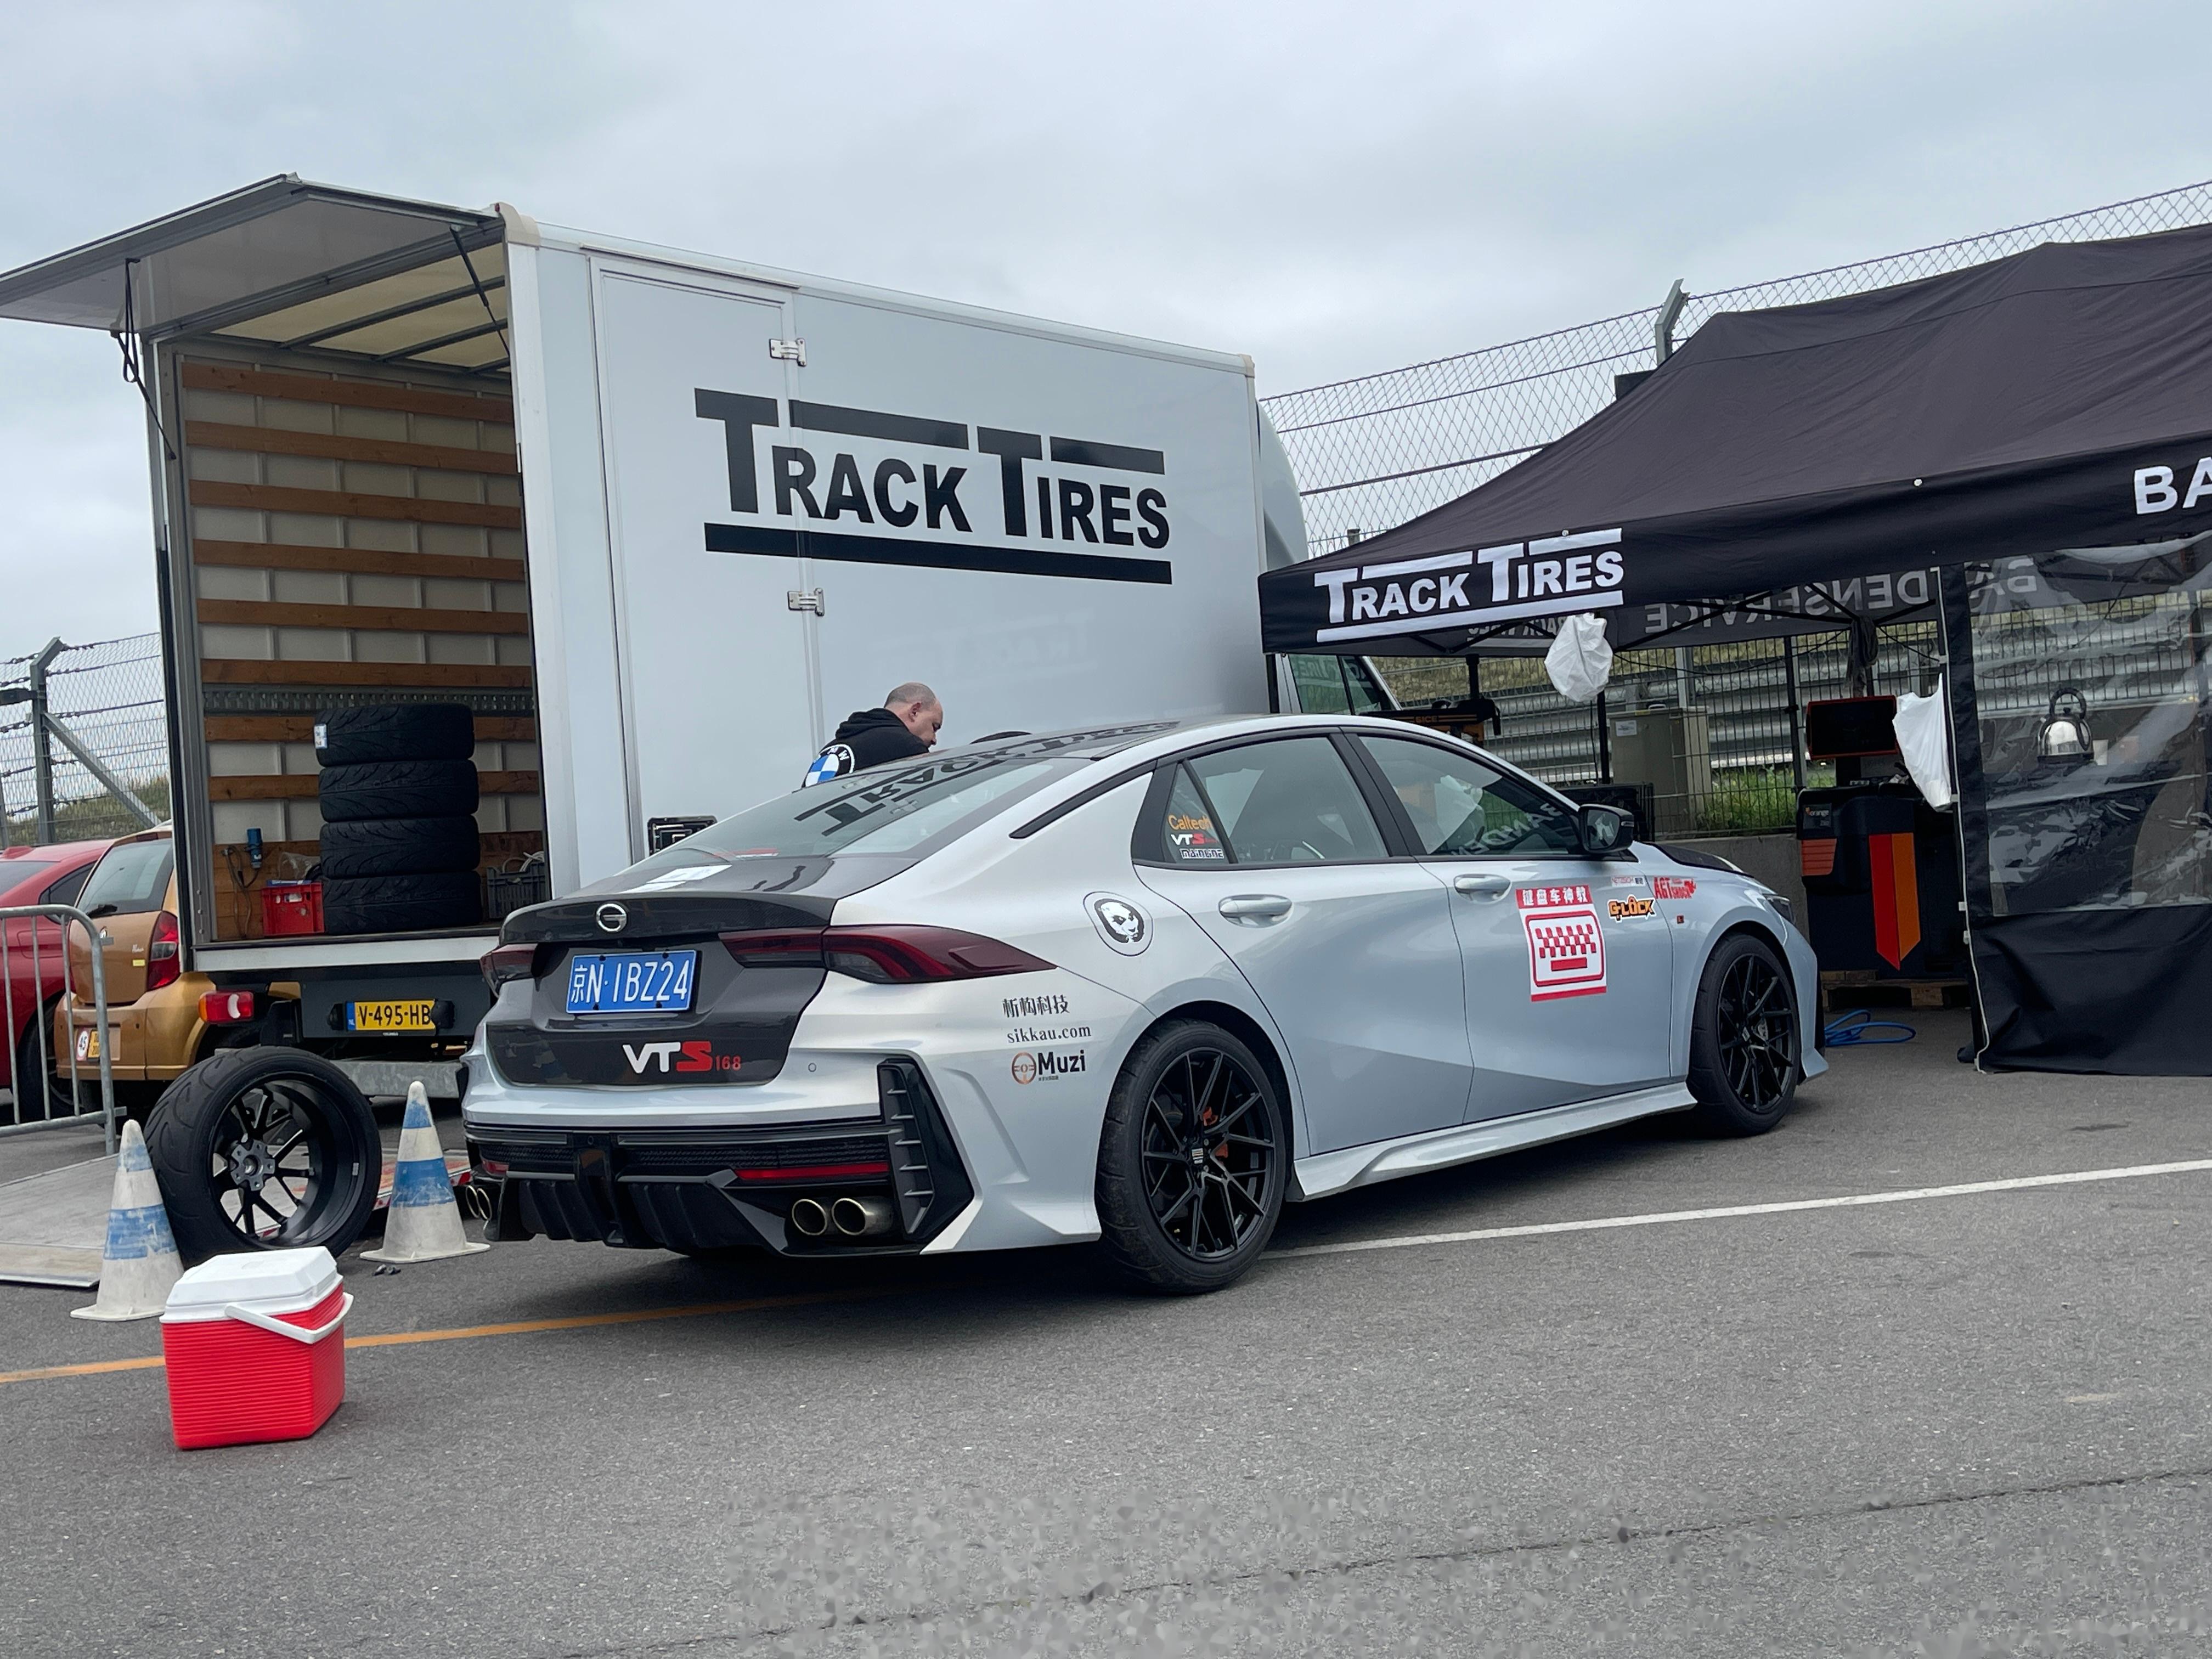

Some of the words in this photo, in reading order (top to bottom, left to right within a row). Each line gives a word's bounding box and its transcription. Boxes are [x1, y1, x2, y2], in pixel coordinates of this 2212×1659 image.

[695, 387, 973, 533] TRACK
[977, 426, 1170, 549] TIRES
[1314, 567, 1470, 624] TRACK
[1477, 542, 1624, 602] TIRES
[1007, 1026, 1091, 1043] sikkau.com
[622, 1040, 713, 1074] VTS
[1037, 1049, 1086, 1075] Muzi
